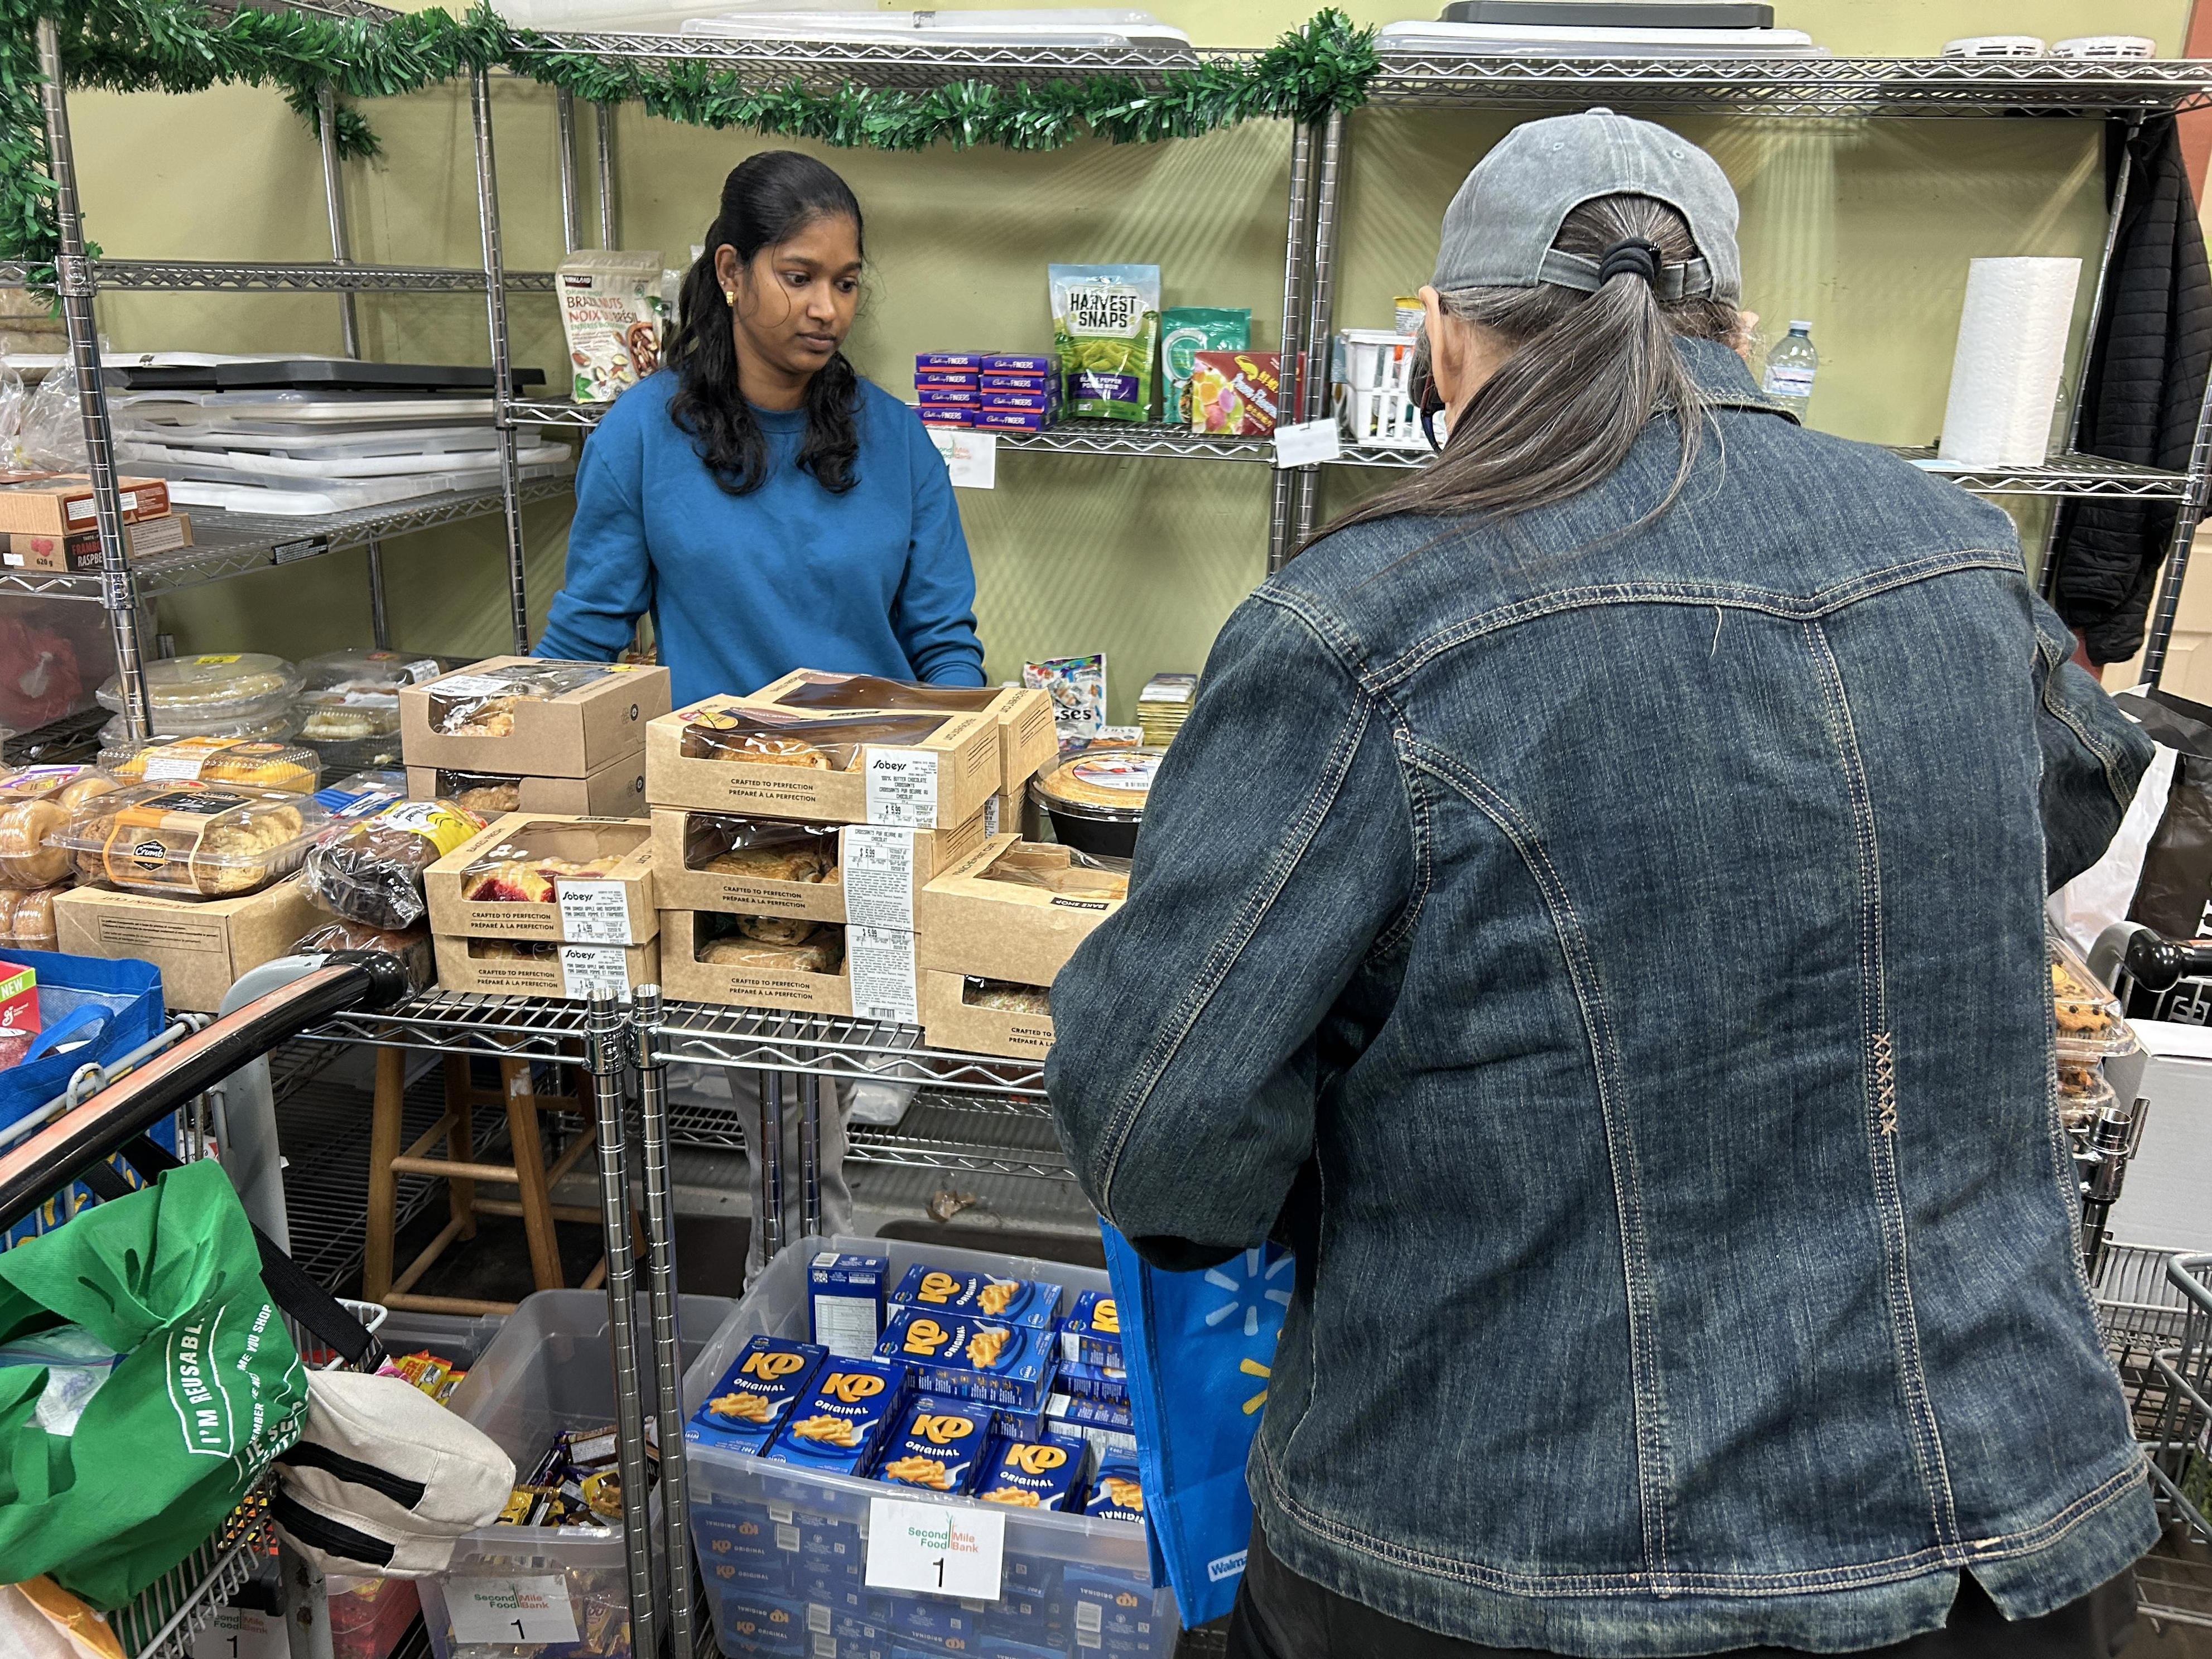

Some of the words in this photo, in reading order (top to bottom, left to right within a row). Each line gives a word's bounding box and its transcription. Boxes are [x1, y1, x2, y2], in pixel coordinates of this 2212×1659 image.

[1070, 293, 1137, 314] HARVEST
[568, 310, 600, 322] NOIX
[1079, 311, 1127, 328] SNAPS
[873, 759, 907, 771] Sobeys
[773, 782, 813, 790] PERFECTION
[135, 847, 163, 858] Crumb
[562, 891, 593, 902] Sobeys
[763, 890, 802, 898] PERFECTION
[565, 949, 595, 960] Sobeys
[1, 977, 23, 999] NEW
[775, 991, 813, 1000] PERFECTION
[1011, 1027, 1041, 1035] CRAFTED
[918, 1272, 961, 1304] KD
[956, 1277, 977, 1306] ORIGINAL
[252, 1304, 272, 1333] SHOP
[246, 1334, 261, 1353] YOU
[903, 1319, 948, 1356] KD
[944, 1325, 966, 1358] ORIGINAL
[179, 1318, 213, 1405] REUSABL
[741, 1352, 805, 1381] KD
[734, 1378, 785, 1392] ORIGINAL
[821, 1373, 885, 1402] KD
[815, 1400, 869, 1415] ORIGINAL
[195, 1409, 222, 1444] I'M
[910, 1414, 974, 1444] KD
[905, 1440, 960, 1457] ORIGINAL
[1005, 1444, 1067, 1474] KD
[1000, 1471, 1054, 1487] ORIGINAL
[908, 1527, 947, 1540] Second
[953, 1532, 975, 1543] Mile
[921, 1538, 947, 1550] Food
[952, 1542, 978, 1553] Bank
[933, 1557, 944, 1587] 1
[214, 1621, 239, 1629] Food
[243, 1625, 268, 1634] Bank
[510, 1619, 525, 1639] 1
[226, 1635, 238, 1658] 1
